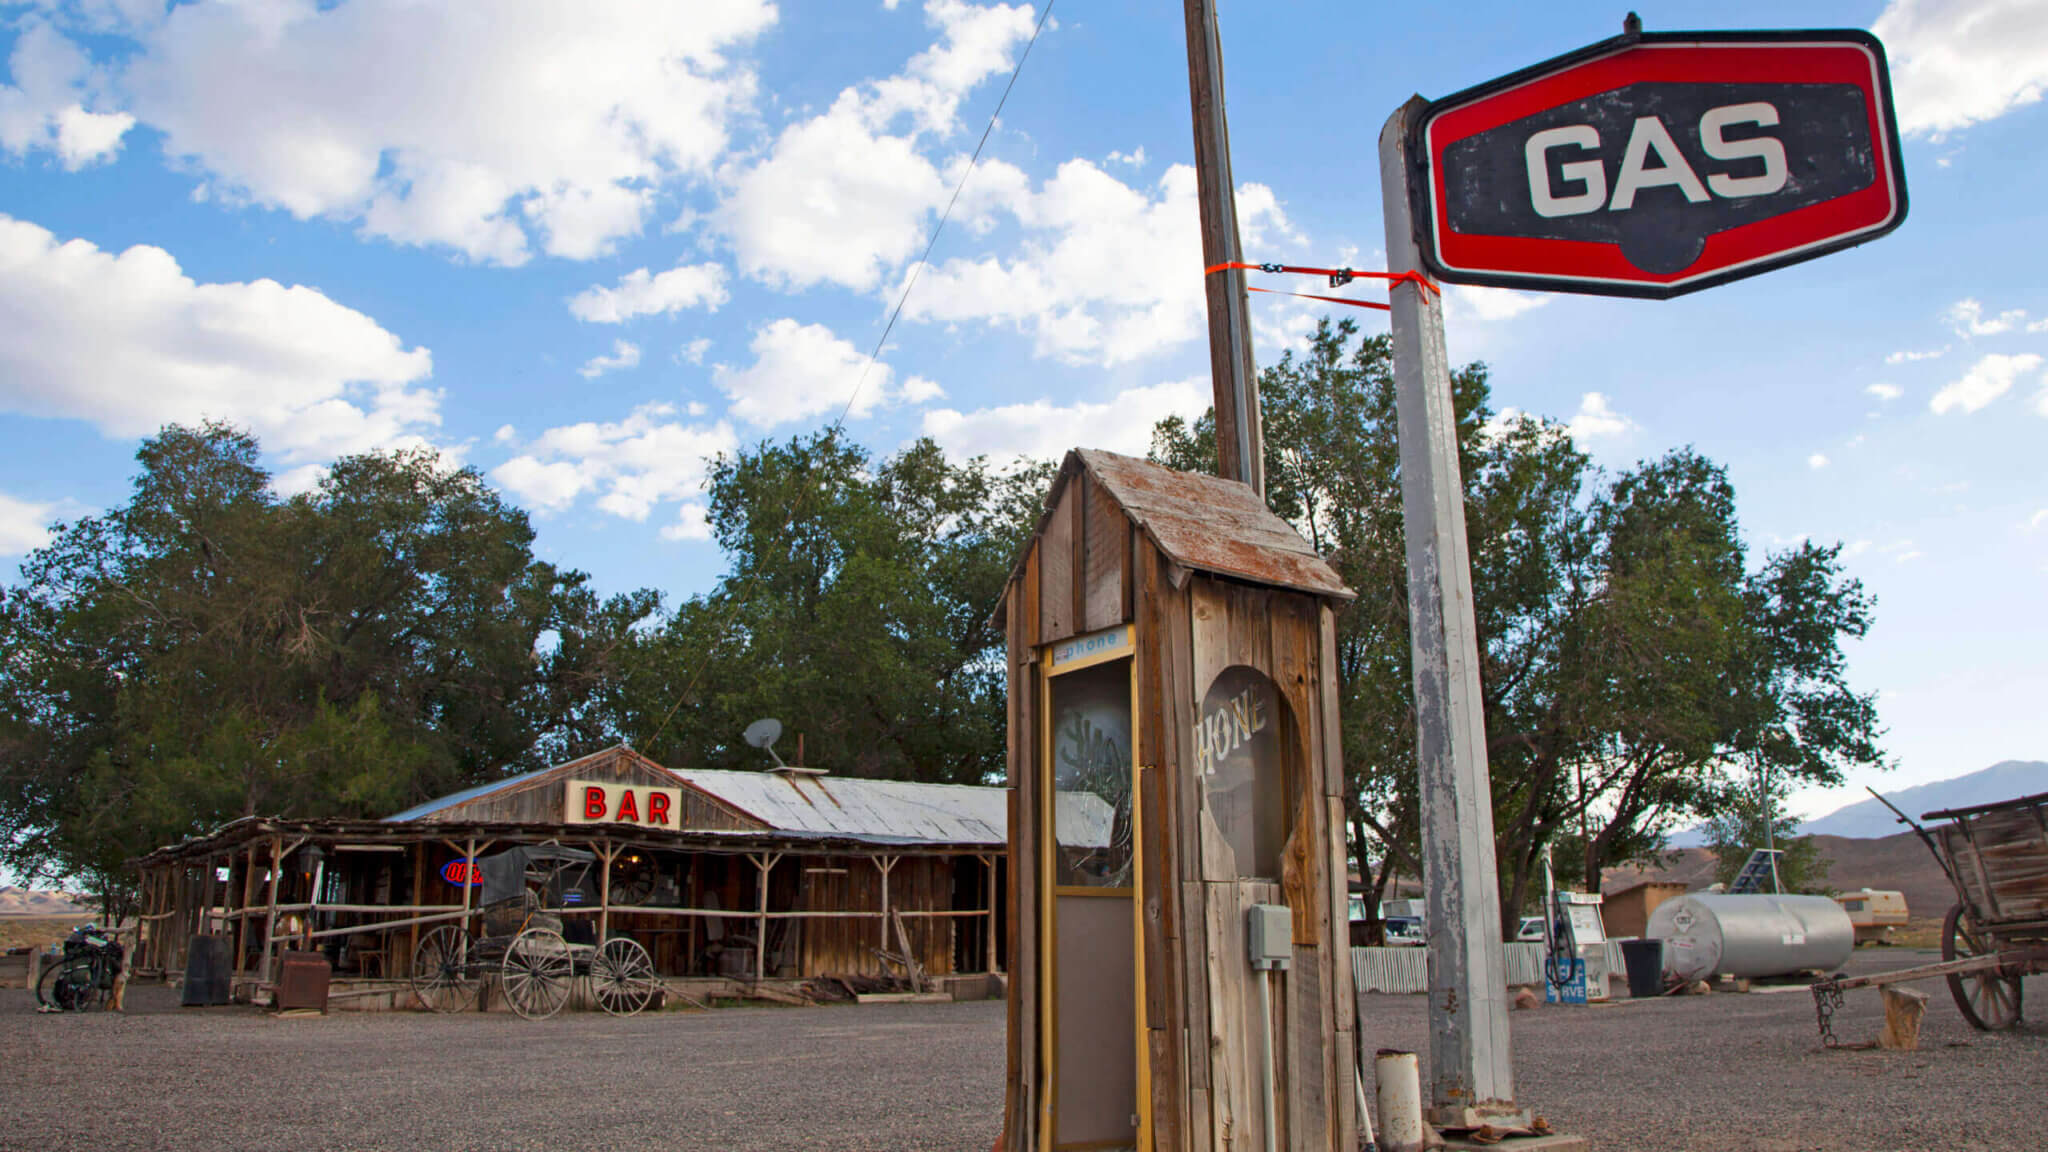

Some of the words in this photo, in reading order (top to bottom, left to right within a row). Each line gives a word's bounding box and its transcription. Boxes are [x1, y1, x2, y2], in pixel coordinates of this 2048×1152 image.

[1525, 101, 1789, 218] GAS
[1067, 633, 1117, 660] phone
[584, 786, 671, 825] BAR
[1548, 985, 1585, 998] SRVE
